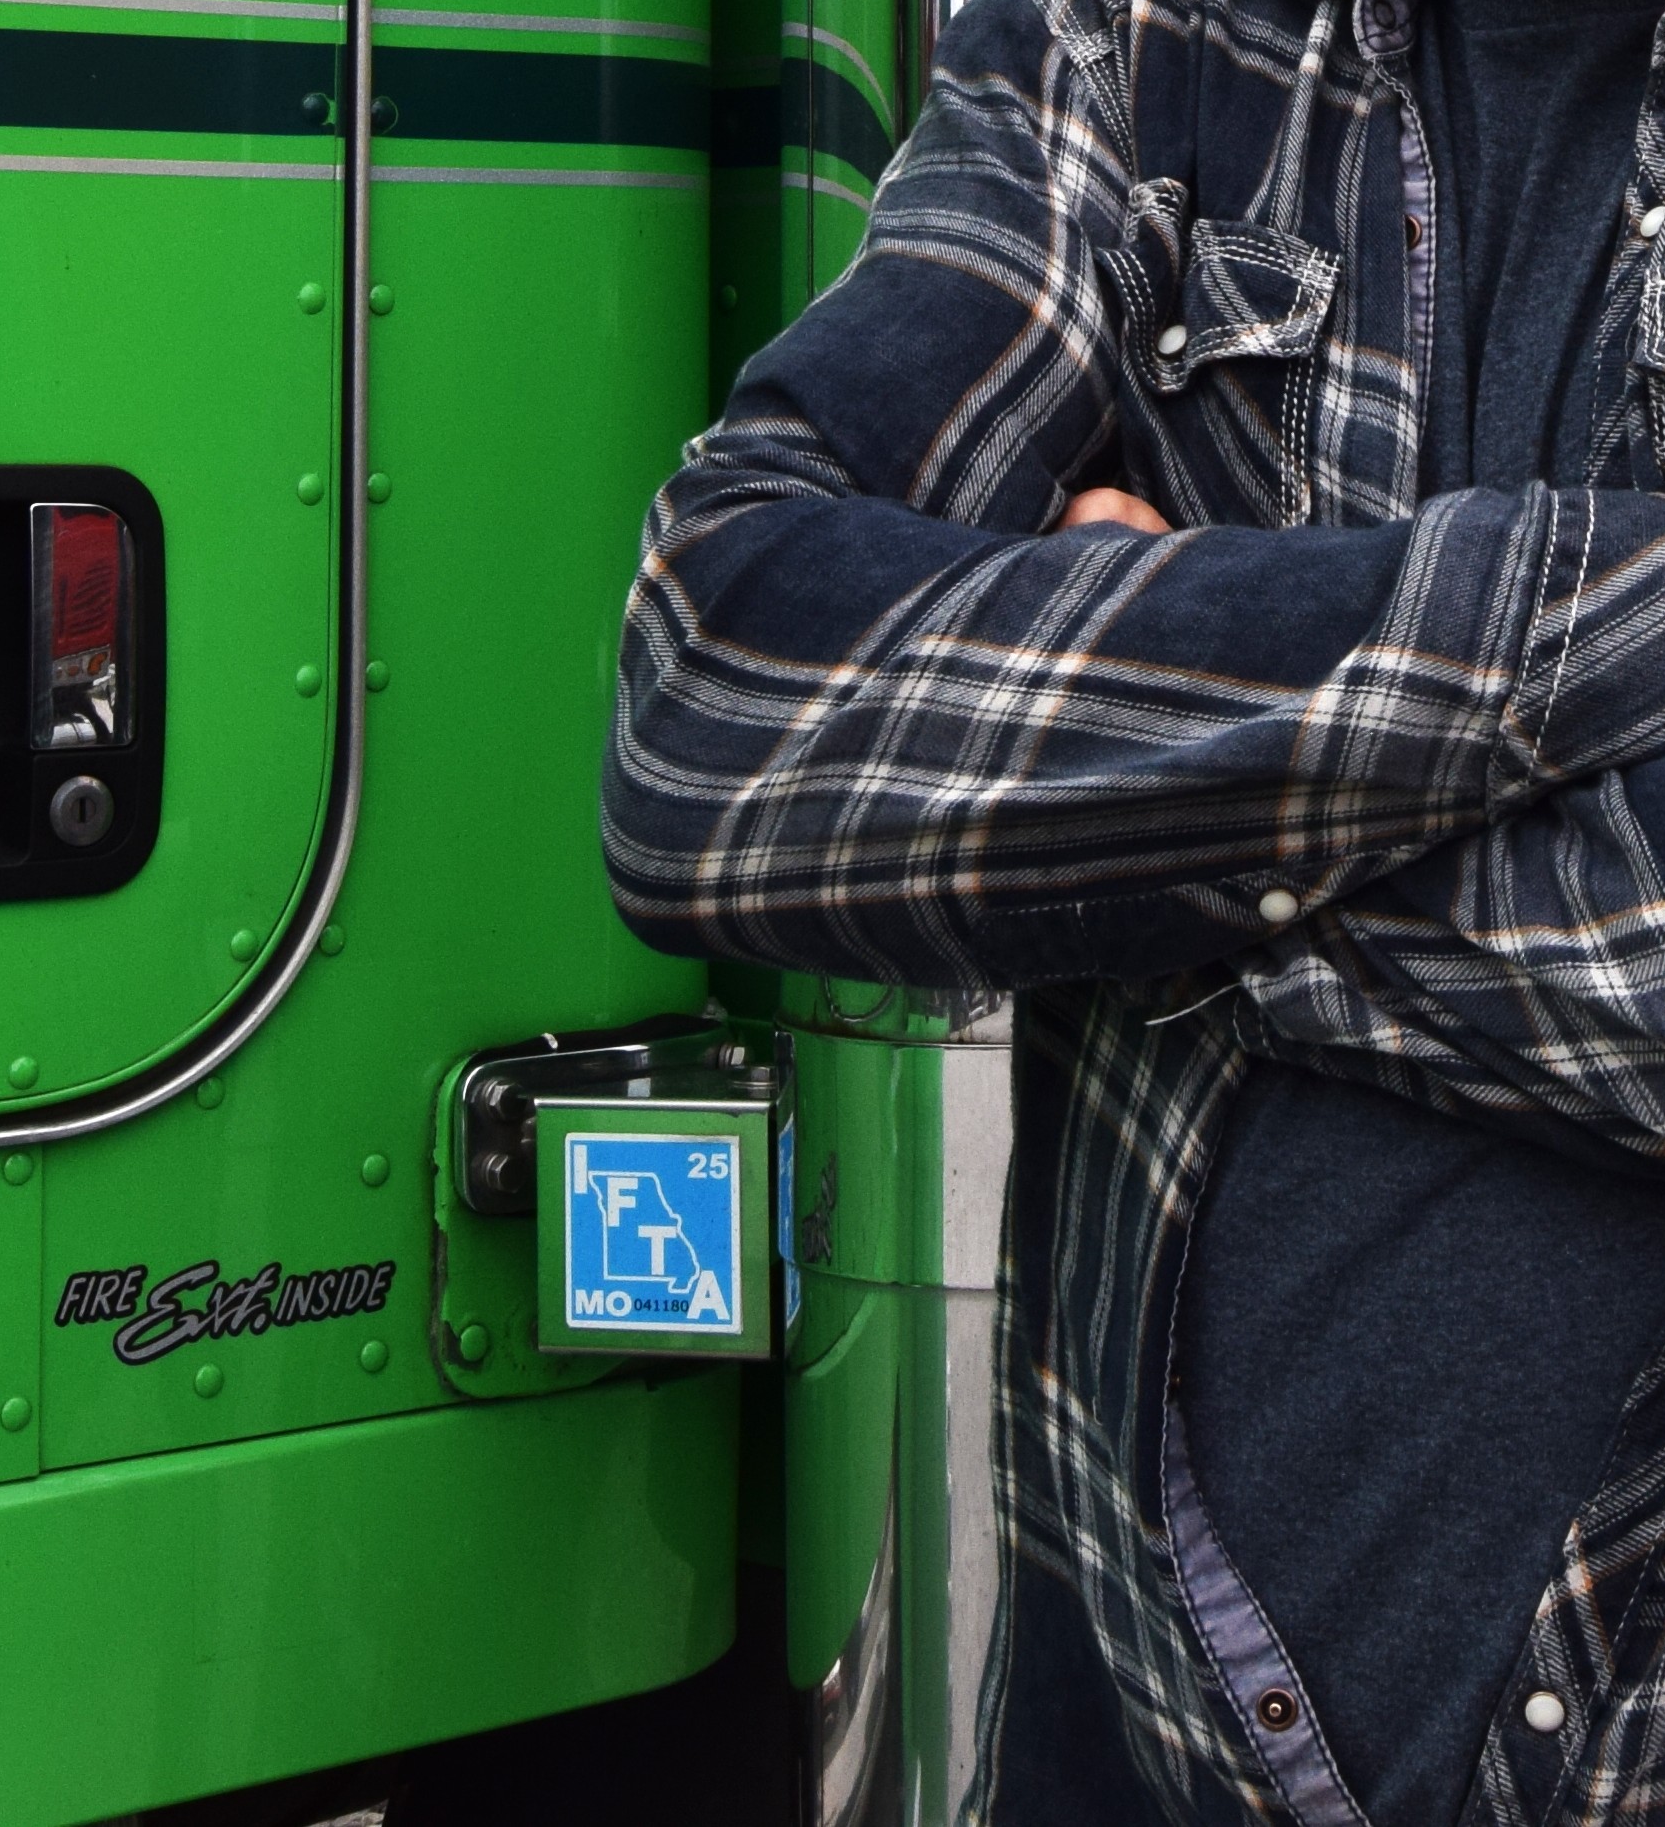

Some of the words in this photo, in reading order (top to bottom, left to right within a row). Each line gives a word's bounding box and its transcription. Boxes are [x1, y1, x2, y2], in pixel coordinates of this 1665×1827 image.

[687, 1152, 729, 1180] 25
[56, 1267, 146, 1325] FIRE
[276, 1263, 395, 1324] INSIDE
[575, 1289, 632, 1316] MO
[634, 1297, 689, 1313] 041180
